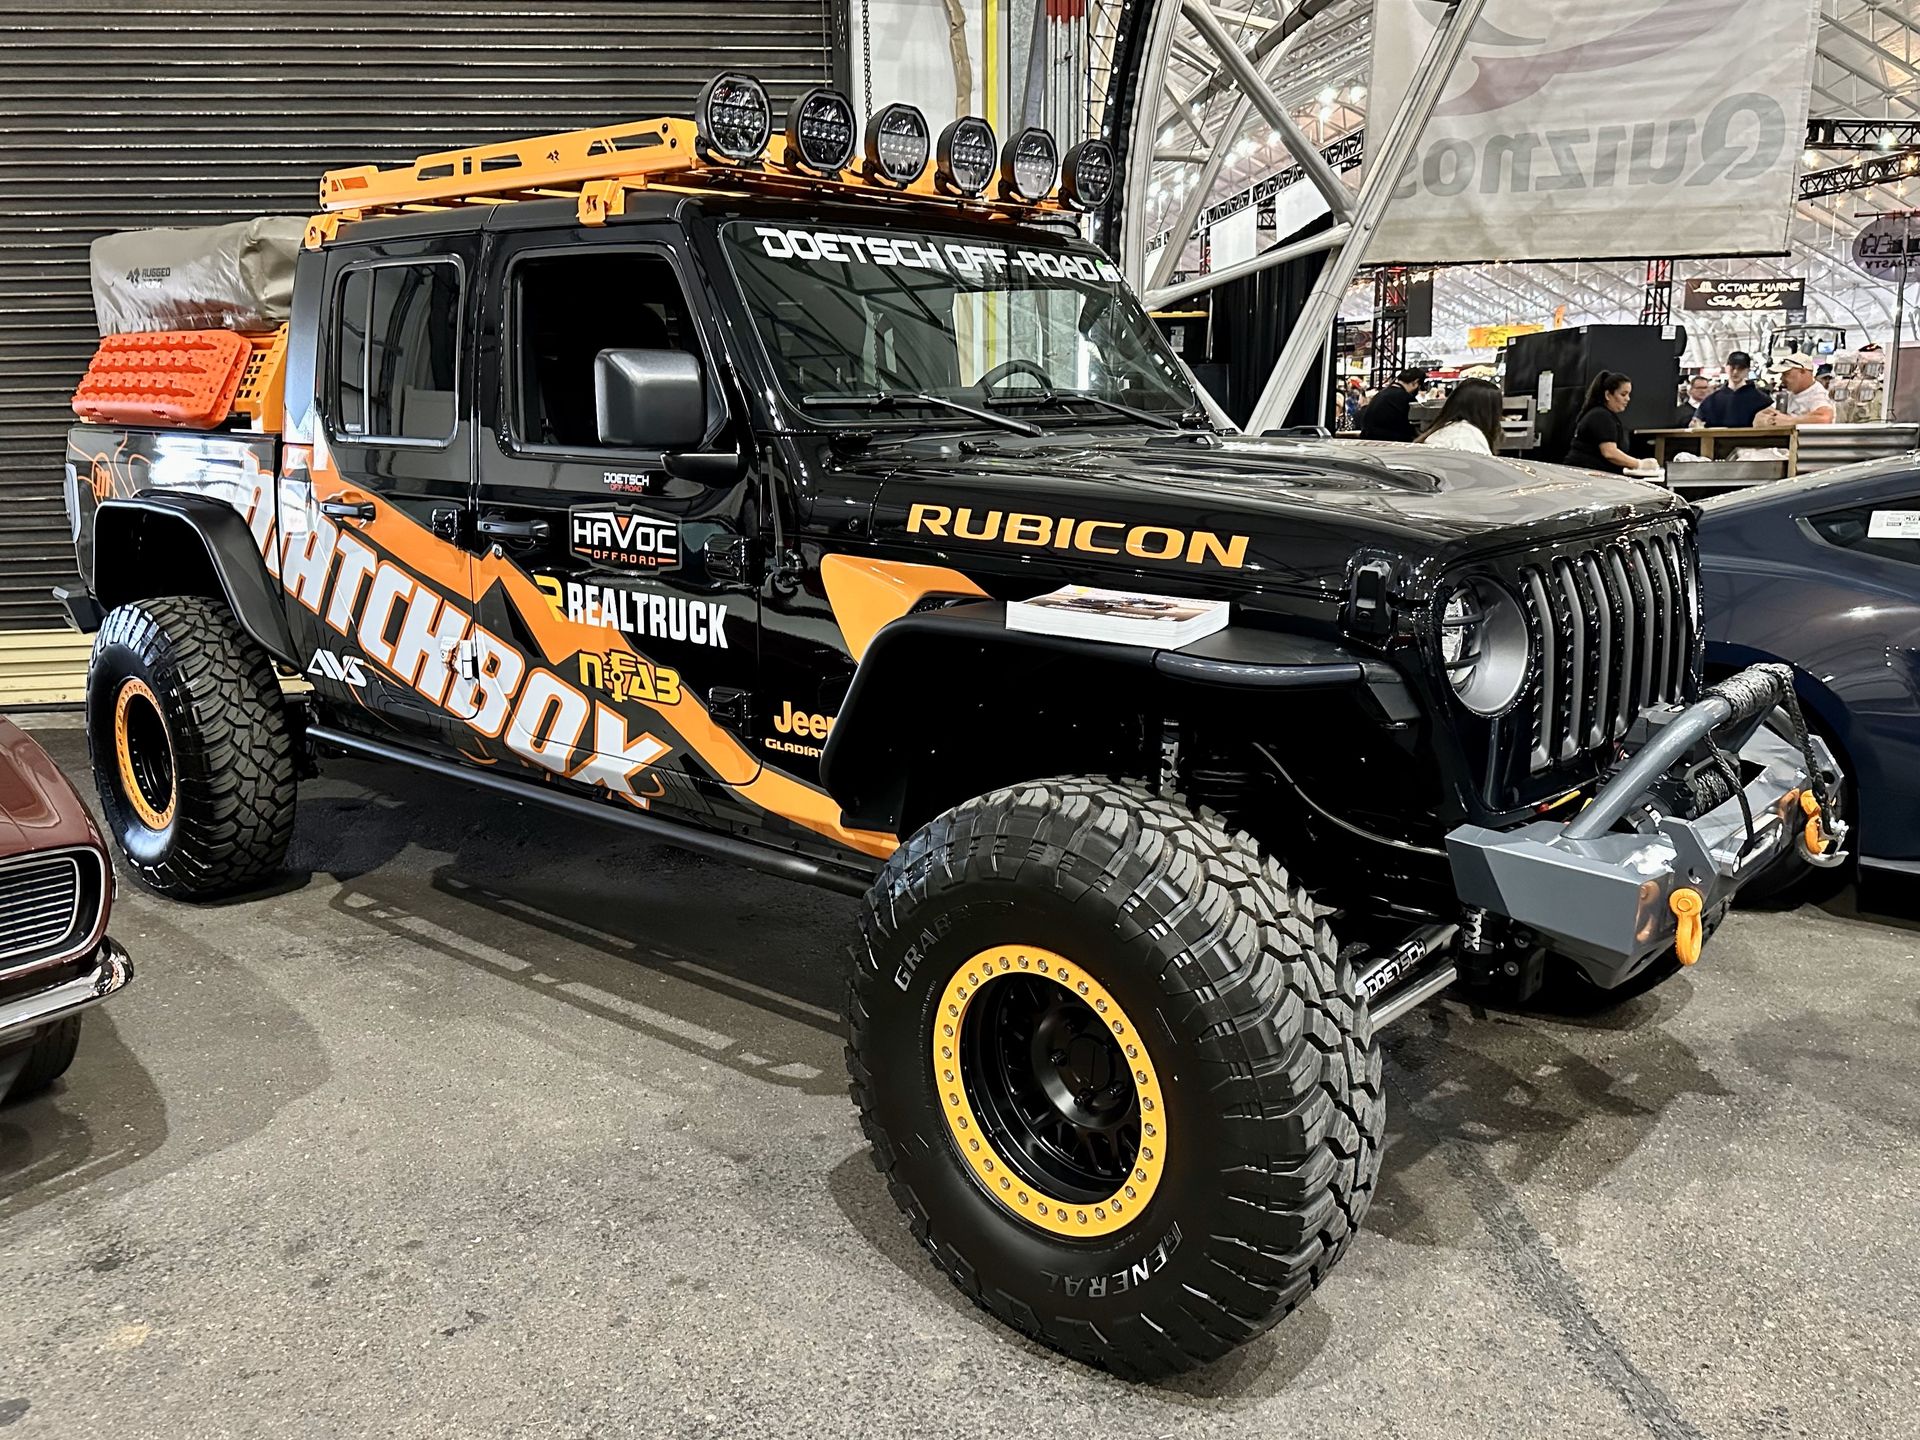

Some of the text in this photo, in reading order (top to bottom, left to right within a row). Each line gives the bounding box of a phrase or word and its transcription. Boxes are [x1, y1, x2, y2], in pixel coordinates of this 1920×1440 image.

[142, 267, 171, 278] RUGGED
[755, 227, 946, 269] DOETSCH
[944, 244, 1099, 281] OFF-ROAD
[1717, 282, 1800, 292] OCTANE MARINE
[604, 472, 649, 486] DOETSCH
[610, 484, 642, 492] OFF-ROAD
[573, 512, 677, 554] HAVOC
[906, 503, 1250, 568] RUBICON
[593, 550, 656, 565] OFFROAD
[236, 451, 672, 808] MATCHBOX
[567, 582, 729, 648] REALTRUCK
[307, 648, 367, 687] AVS
[1463, 911, 1482, 951] FOX
[1365, 940, 1426, 997] DOETSCH
[1040, 1221, 1183, 1298] GENERAL
